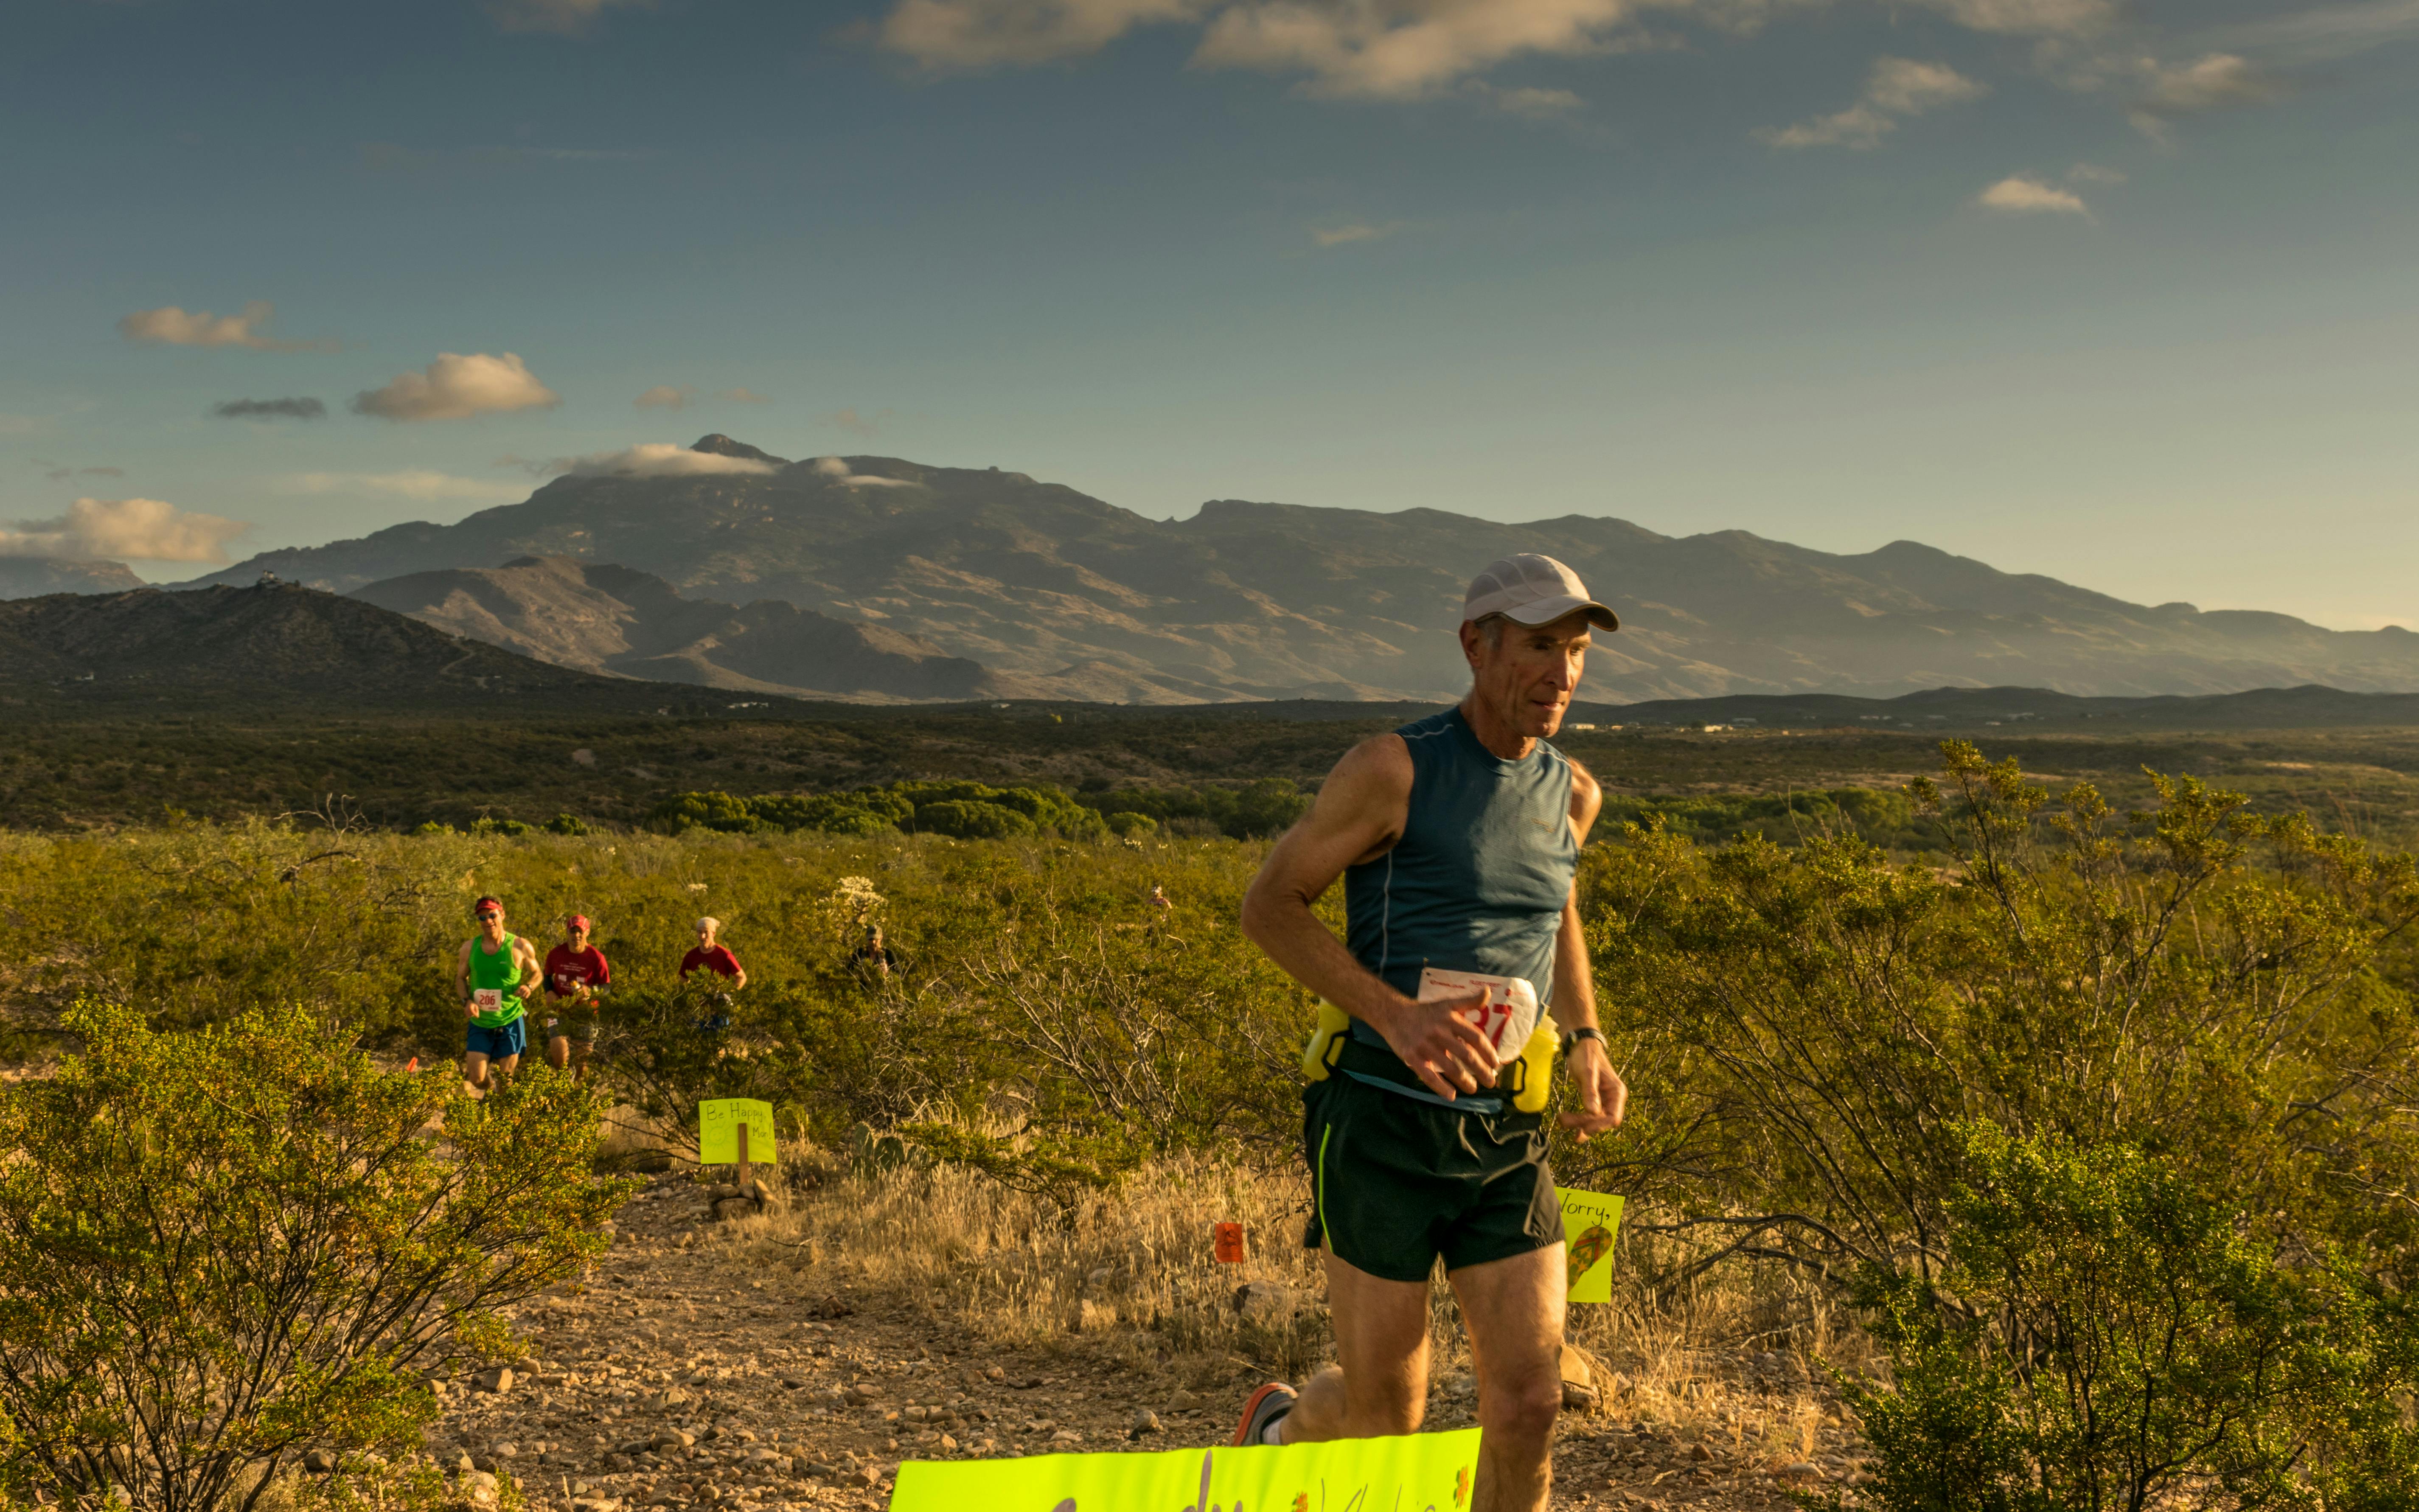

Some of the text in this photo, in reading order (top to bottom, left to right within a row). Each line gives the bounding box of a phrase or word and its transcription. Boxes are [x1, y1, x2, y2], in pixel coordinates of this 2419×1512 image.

[480, 995, 495, 1005] 206
[707, 1104, 724, 1120] Be
[752, 1122, 772, 1139] Mon!
